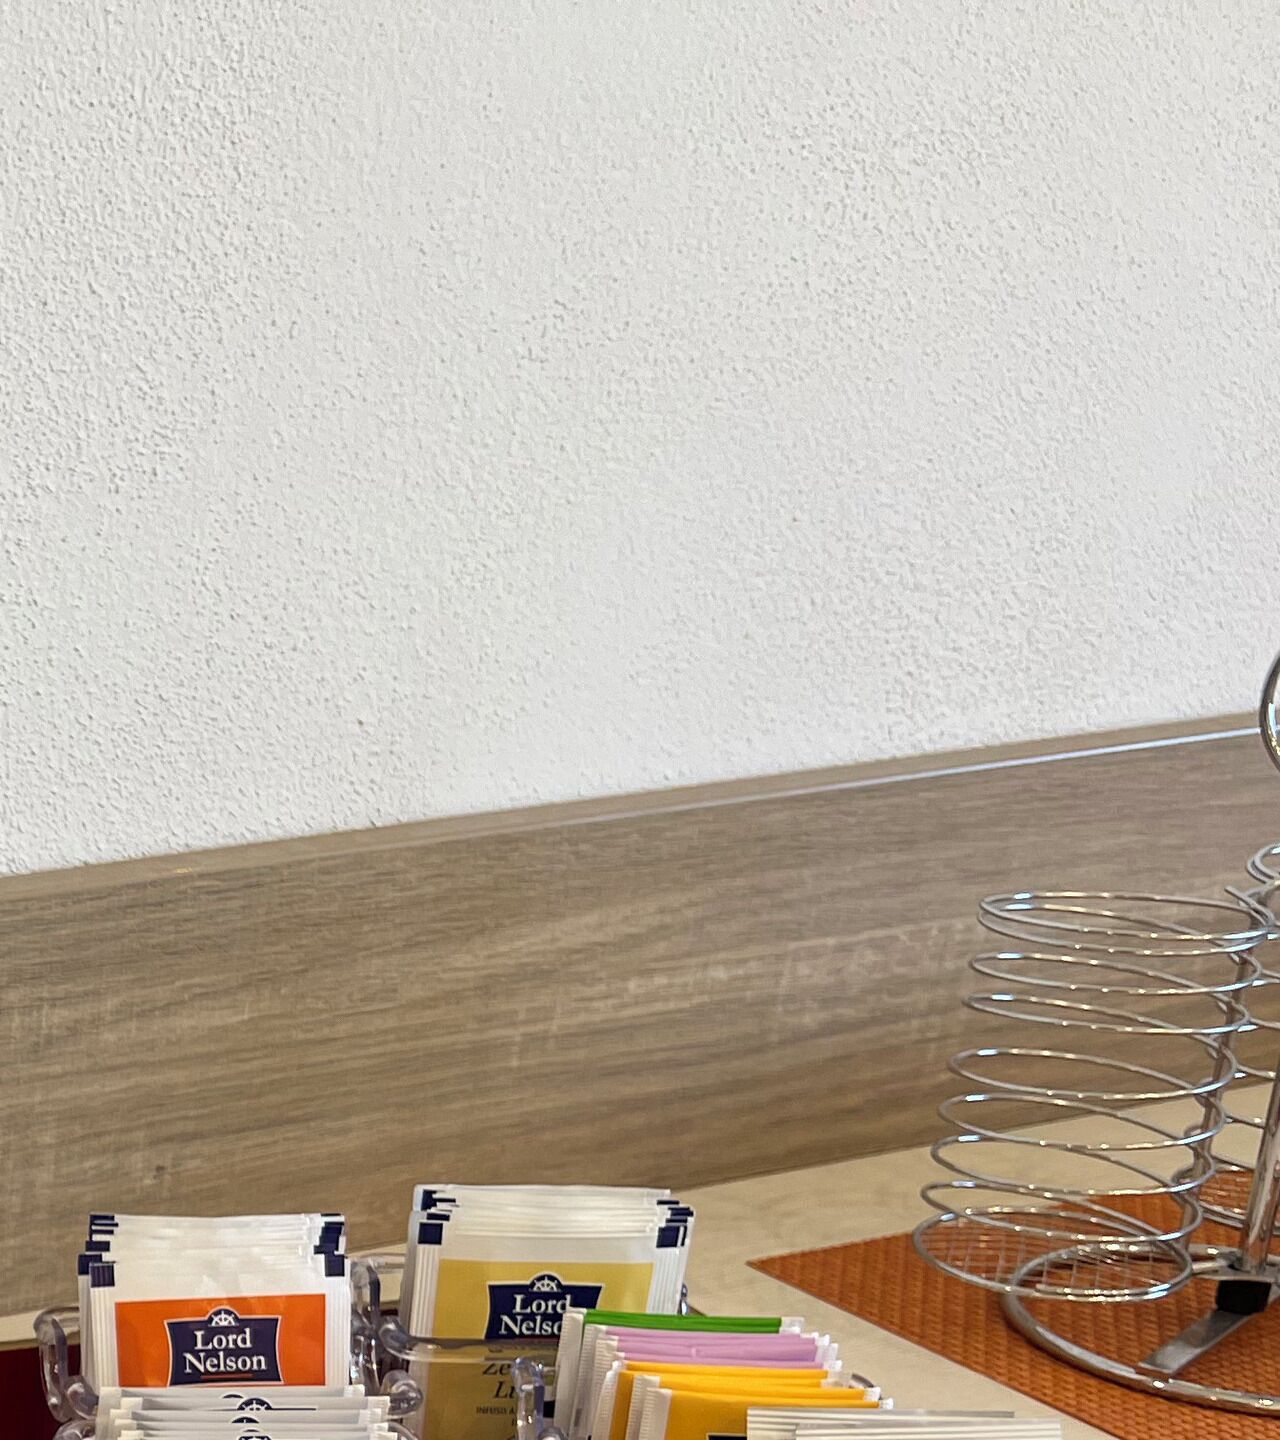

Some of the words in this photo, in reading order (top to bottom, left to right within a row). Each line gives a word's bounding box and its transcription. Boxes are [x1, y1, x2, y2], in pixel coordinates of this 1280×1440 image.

[512, 1293, 571, 1314] Lord
[194, 1327, 252, 1350] Lord
[183, 1352, 267, 1373] Nelson
